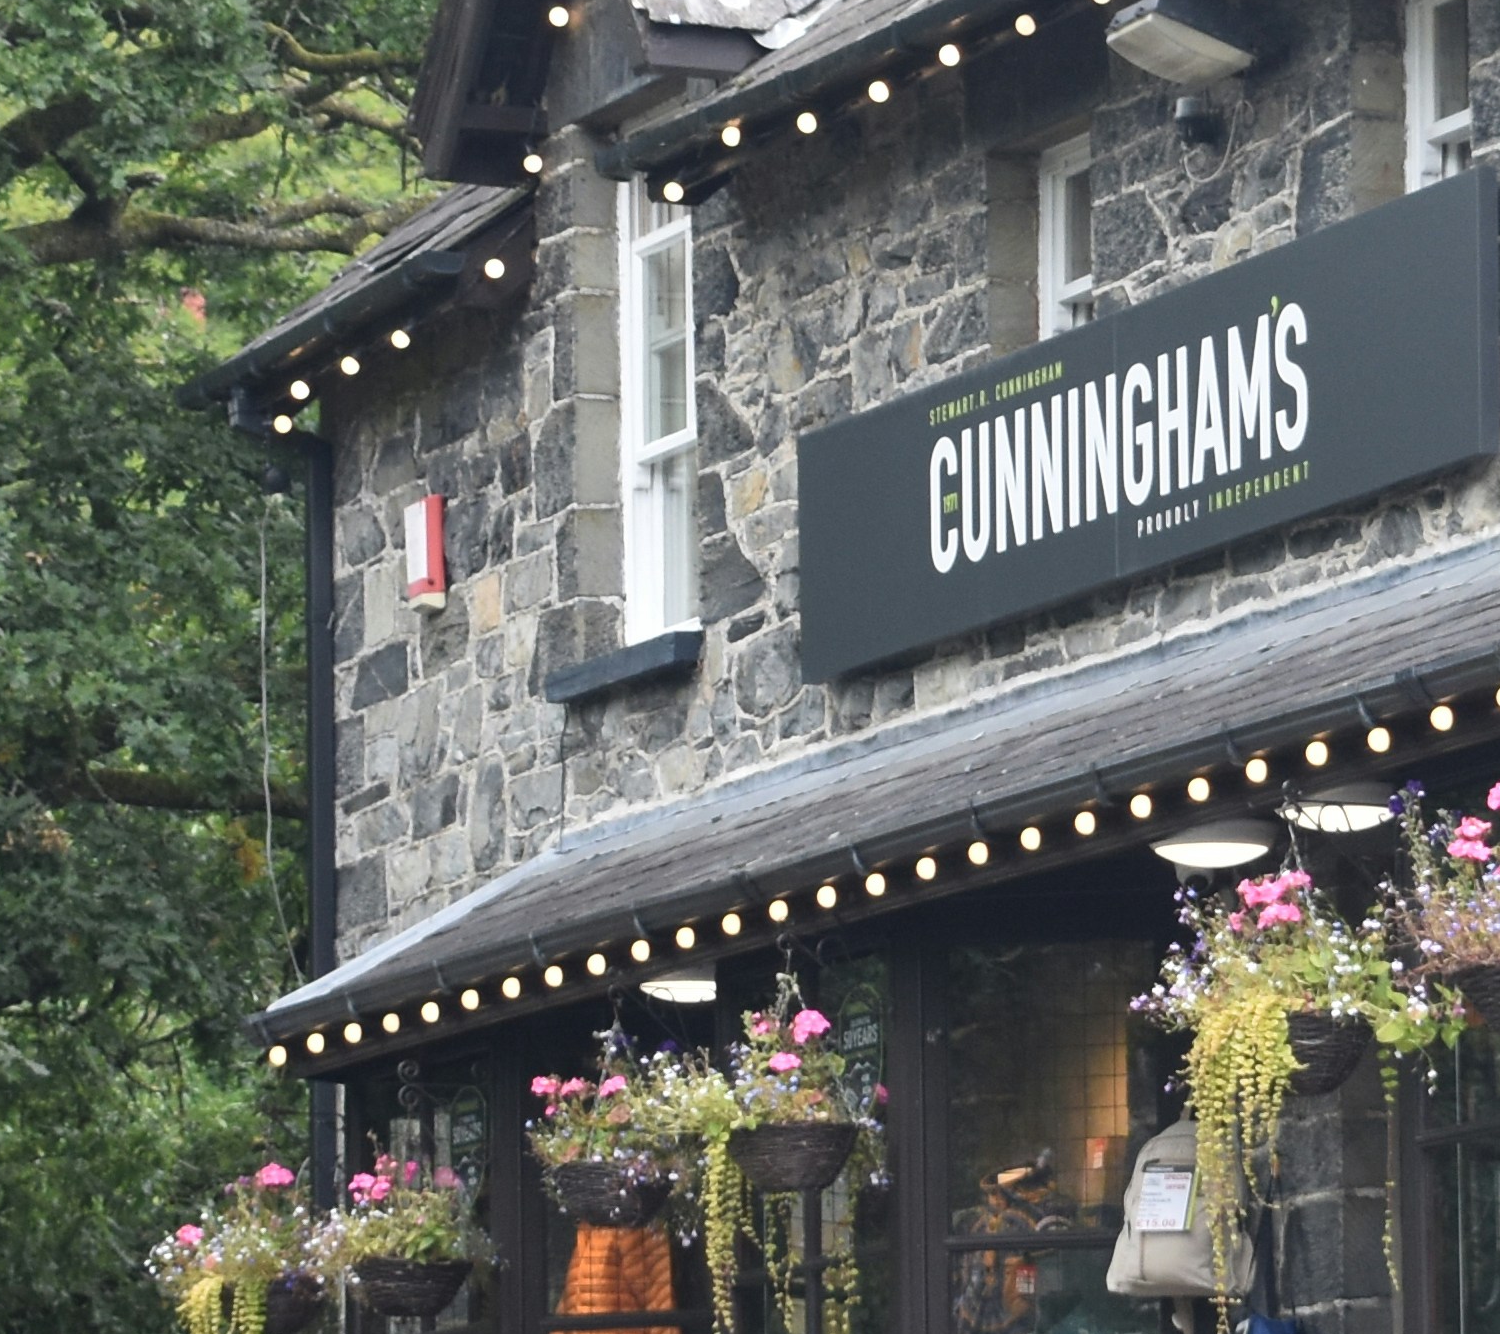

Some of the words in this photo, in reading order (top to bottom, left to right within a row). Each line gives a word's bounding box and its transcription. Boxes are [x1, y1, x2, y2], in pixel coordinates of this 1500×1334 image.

[995, 361, 1063, 402] CUNNINGHAM
[929, 294, 1309, 574] CUNNINGHAM'S
[943, 492, 958, 514] 1971
[1137, 499, 1200, 538] PROUDLY
[1208, 460, 1310, 513] INDEPENDENT
[1136, 1218, 1176, 1228] £15.00
